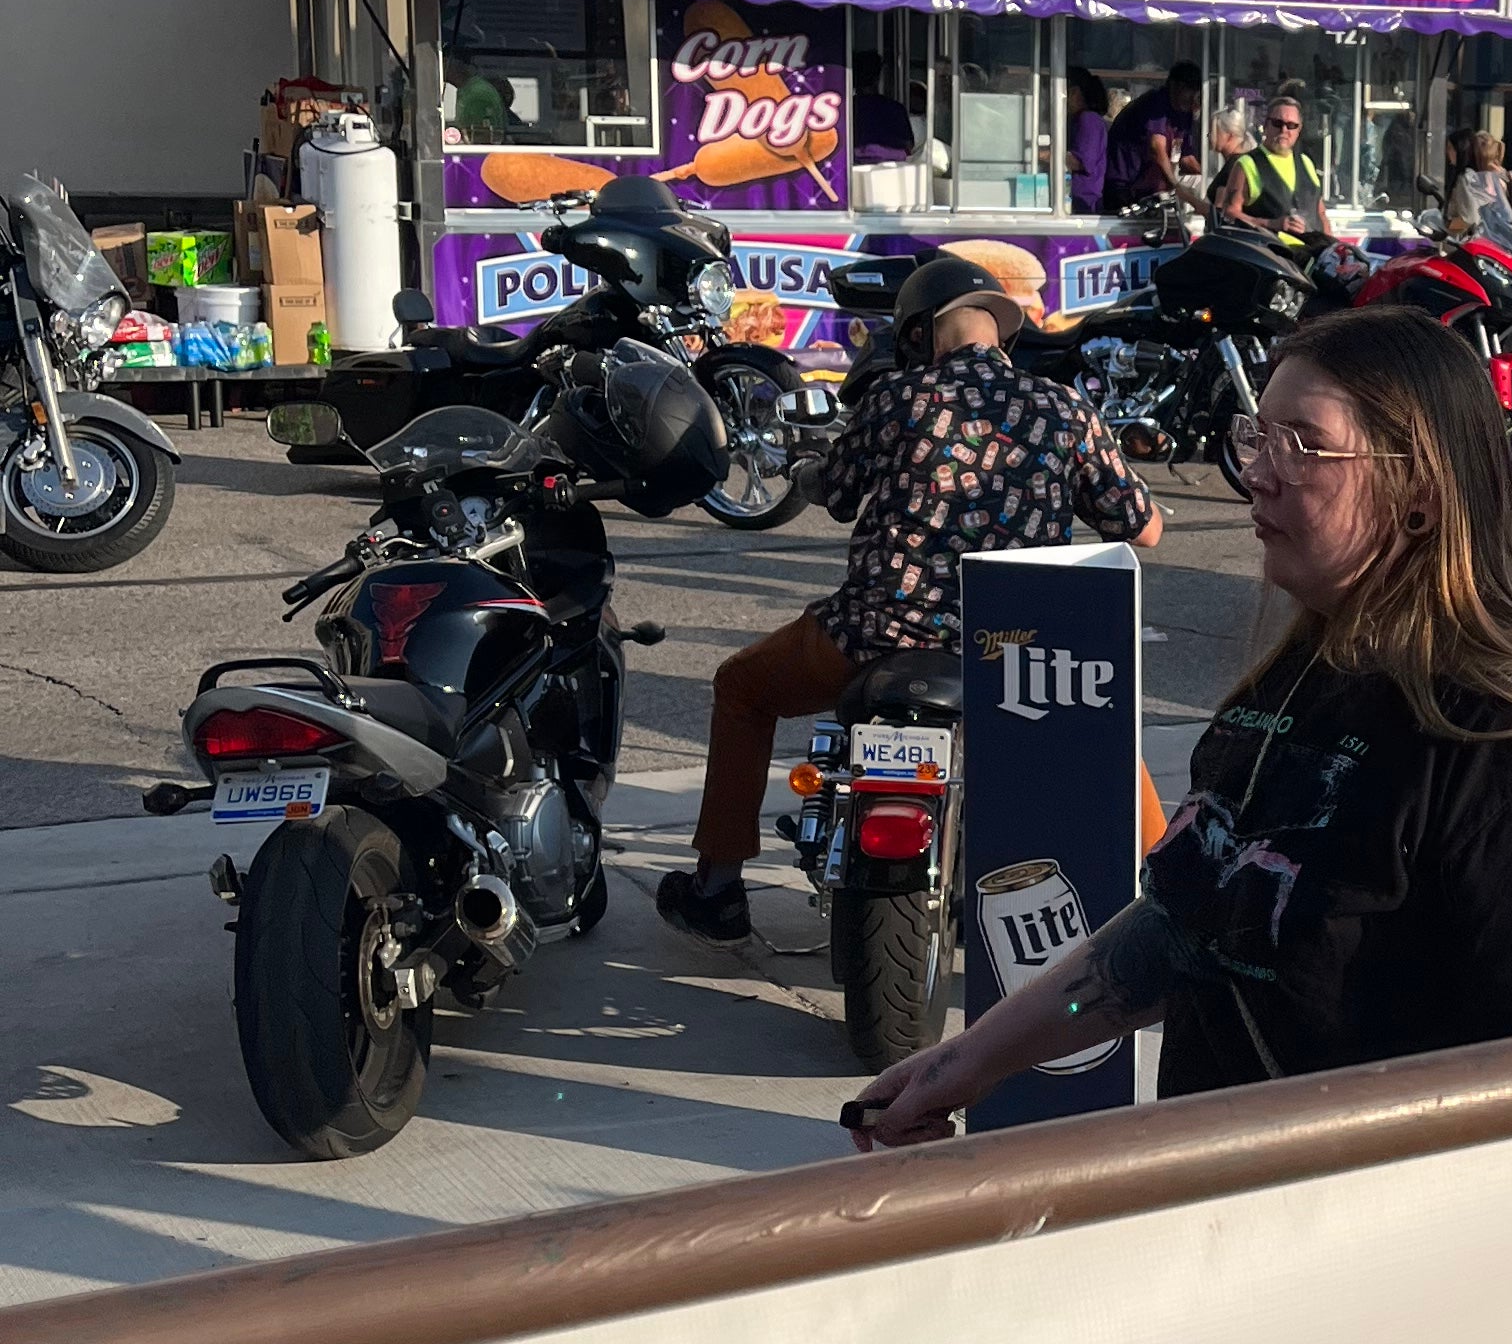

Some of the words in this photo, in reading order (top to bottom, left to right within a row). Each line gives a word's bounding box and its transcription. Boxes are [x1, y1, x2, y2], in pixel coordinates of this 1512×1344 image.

[672, 30, 808, 82] Corn
[697, 88, 843, 146] Dogs
[498, 261, 602, 307] POLI
[973, 628, 1038, 661] Miller
[996, 642, 1114, 721] Lite
[862, 743, 937, 764] WE481
[226, 783, 313, 804] UW966
[998, 901, 1079, 966] Lite
